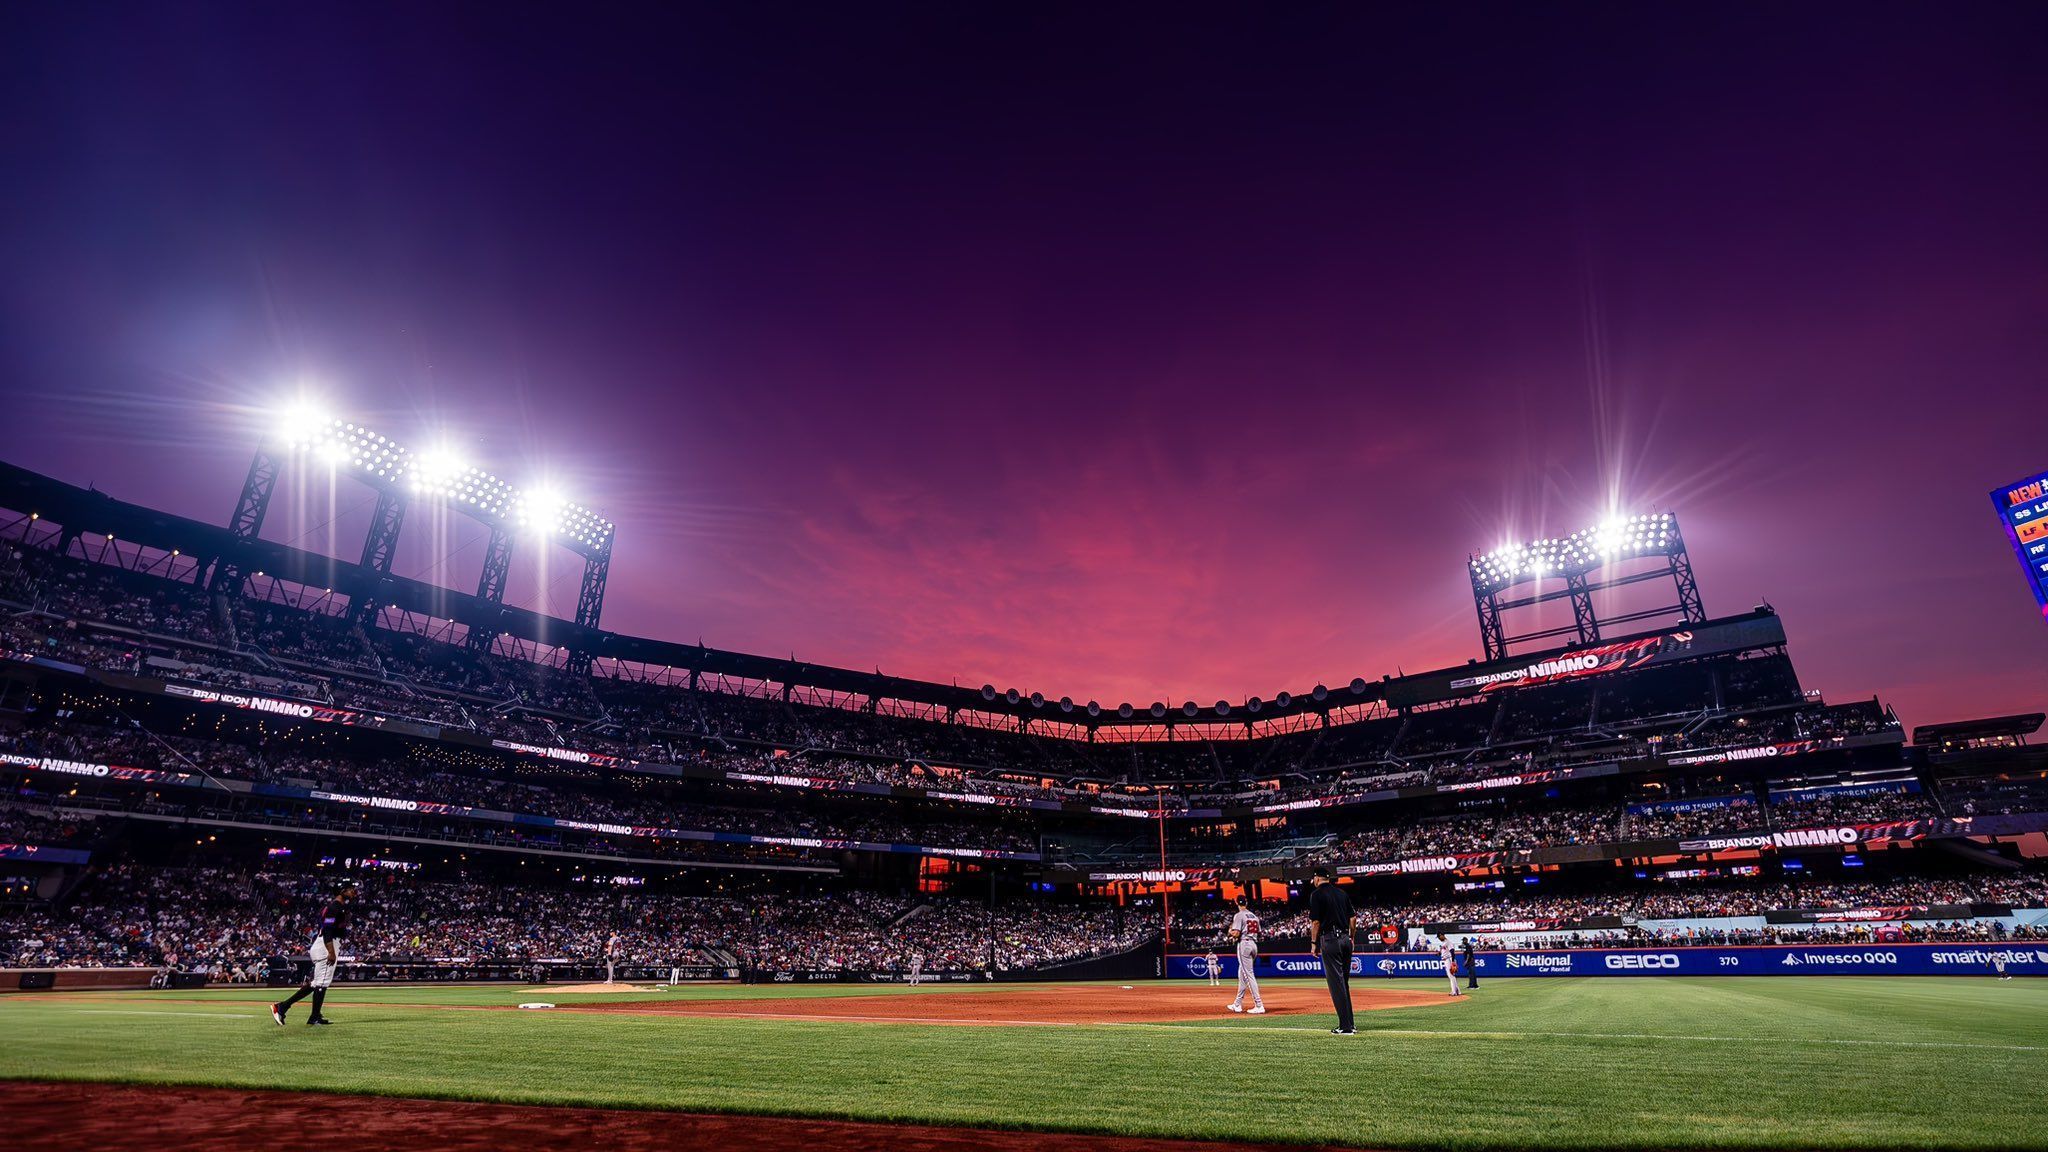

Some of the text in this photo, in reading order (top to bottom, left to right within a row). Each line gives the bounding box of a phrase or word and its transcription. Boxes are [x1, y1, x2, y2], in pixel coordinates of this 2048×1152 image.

[2009, 482, 2041, 504] NEW
[2015, 509, 2031, 519] SS
[2023, 527, 2037, 536] LF
[2030, 544, 2046, 555] RF
[1475, 668, 1528, 685] BRANDON
[1529, 654, 1599, 678] NIMMO
[193, 689, 249, 705] BRANDON
[250, 697, 313, 717] NIMMO
[510, 743, 589, 763] BRANDON NIMMO
[1687, 746, 1777, 763] BRANDON NIMMO
[41, 758, 109, 777] NIMMO
[741, 774, 811, 787] BRANDON NIMMO
[1451, 776, 1521, 791] BRANDON NIMMO
[330, 793, 417, 811] BRANDON NIMMO
[965, 794, 995, 804] NIMMO
[1290, 799, 1320, 810] NIMMO
[1123, 809, 1148, 818] NIMMO
[598, 824, 632, 835] NIMMO
[791, 838, 822, 848] NIMMO
[1708, 836, 1772, 849] BRANDON
[1772, 827, 1858, 847] NIMMO
[955, 848, 982, 857] NIMMO
[1357, 857, 1457, 873] BRANDON NIMMO
[1106, 870, 1186, 882] BRANDON NIMMO
[1844, 910, 1881, 918] NIMMO
[1500, 921, 1536, 930] NIMMO
[1368, 932, 1381, 941] citi
[1474, 959, 1485, 967] 58
[1605, 954, 1680, 969] GEICO
[1719, 956, 1739, 966] 370
[1804, 952, 1898, 964] Invesco QQQ
[1276, 960, 1322, 971] Canon
[1399, 961, 1446, 971] HYUNDA
[774, 972, 794, 982] Ford
